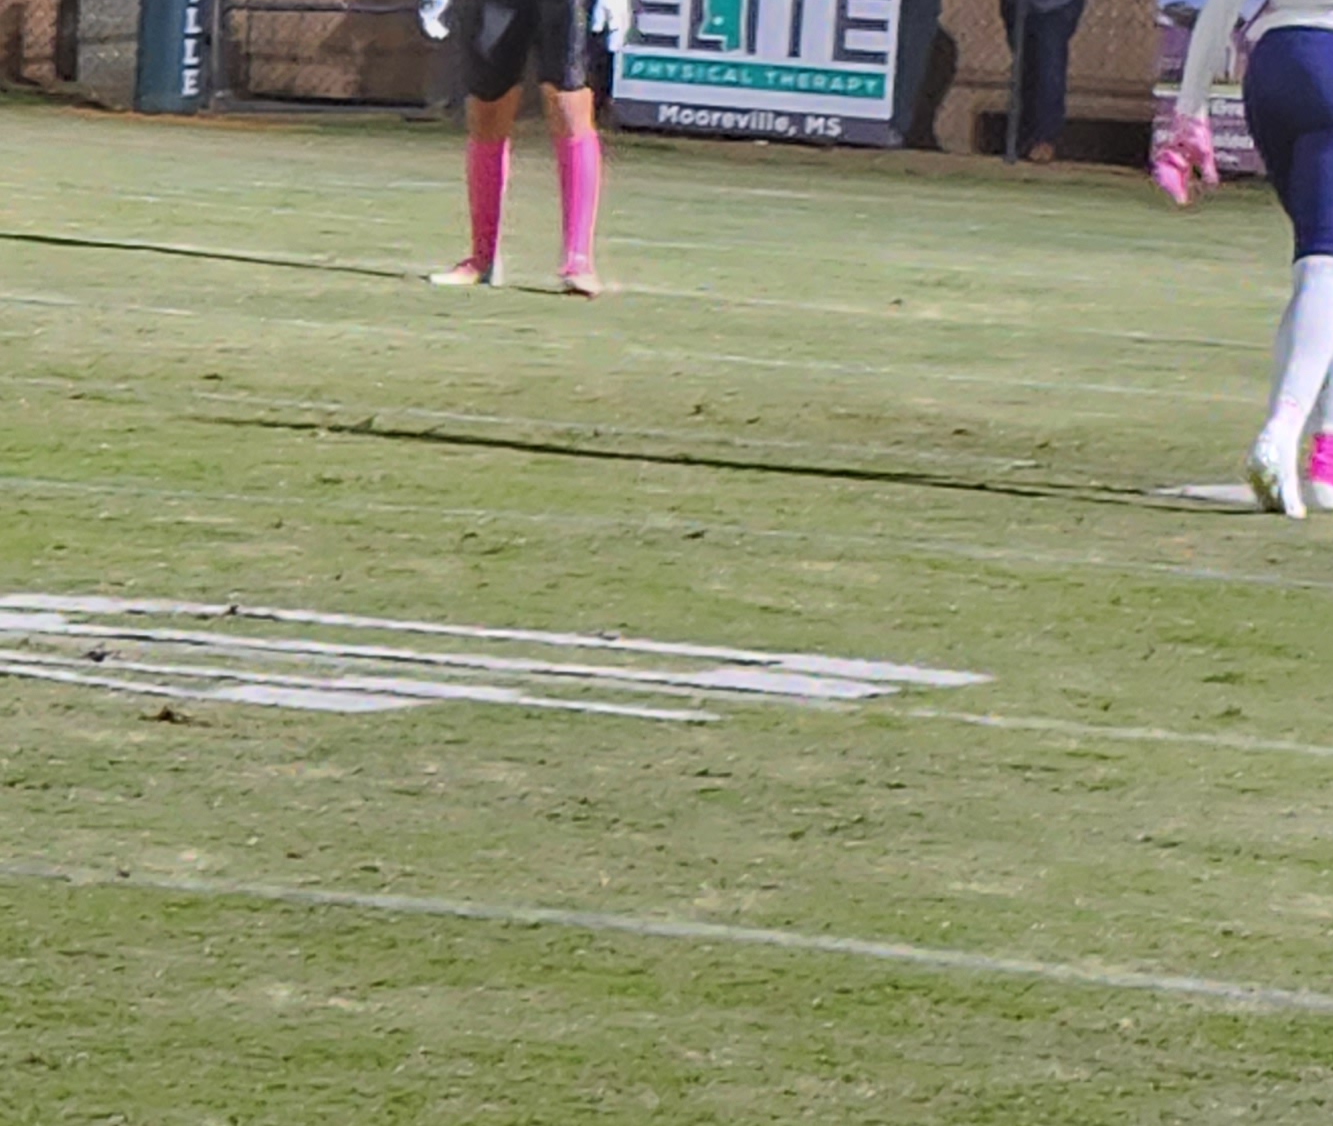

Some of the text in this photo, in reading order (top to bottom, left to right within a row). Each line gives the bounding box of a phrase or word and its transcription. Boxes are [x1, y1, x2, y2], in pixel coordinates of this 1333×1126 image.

[630, 59, 878, 95] PHYSICAL THERAPY
[657, 103, 843, 138] Mooreville, MS
